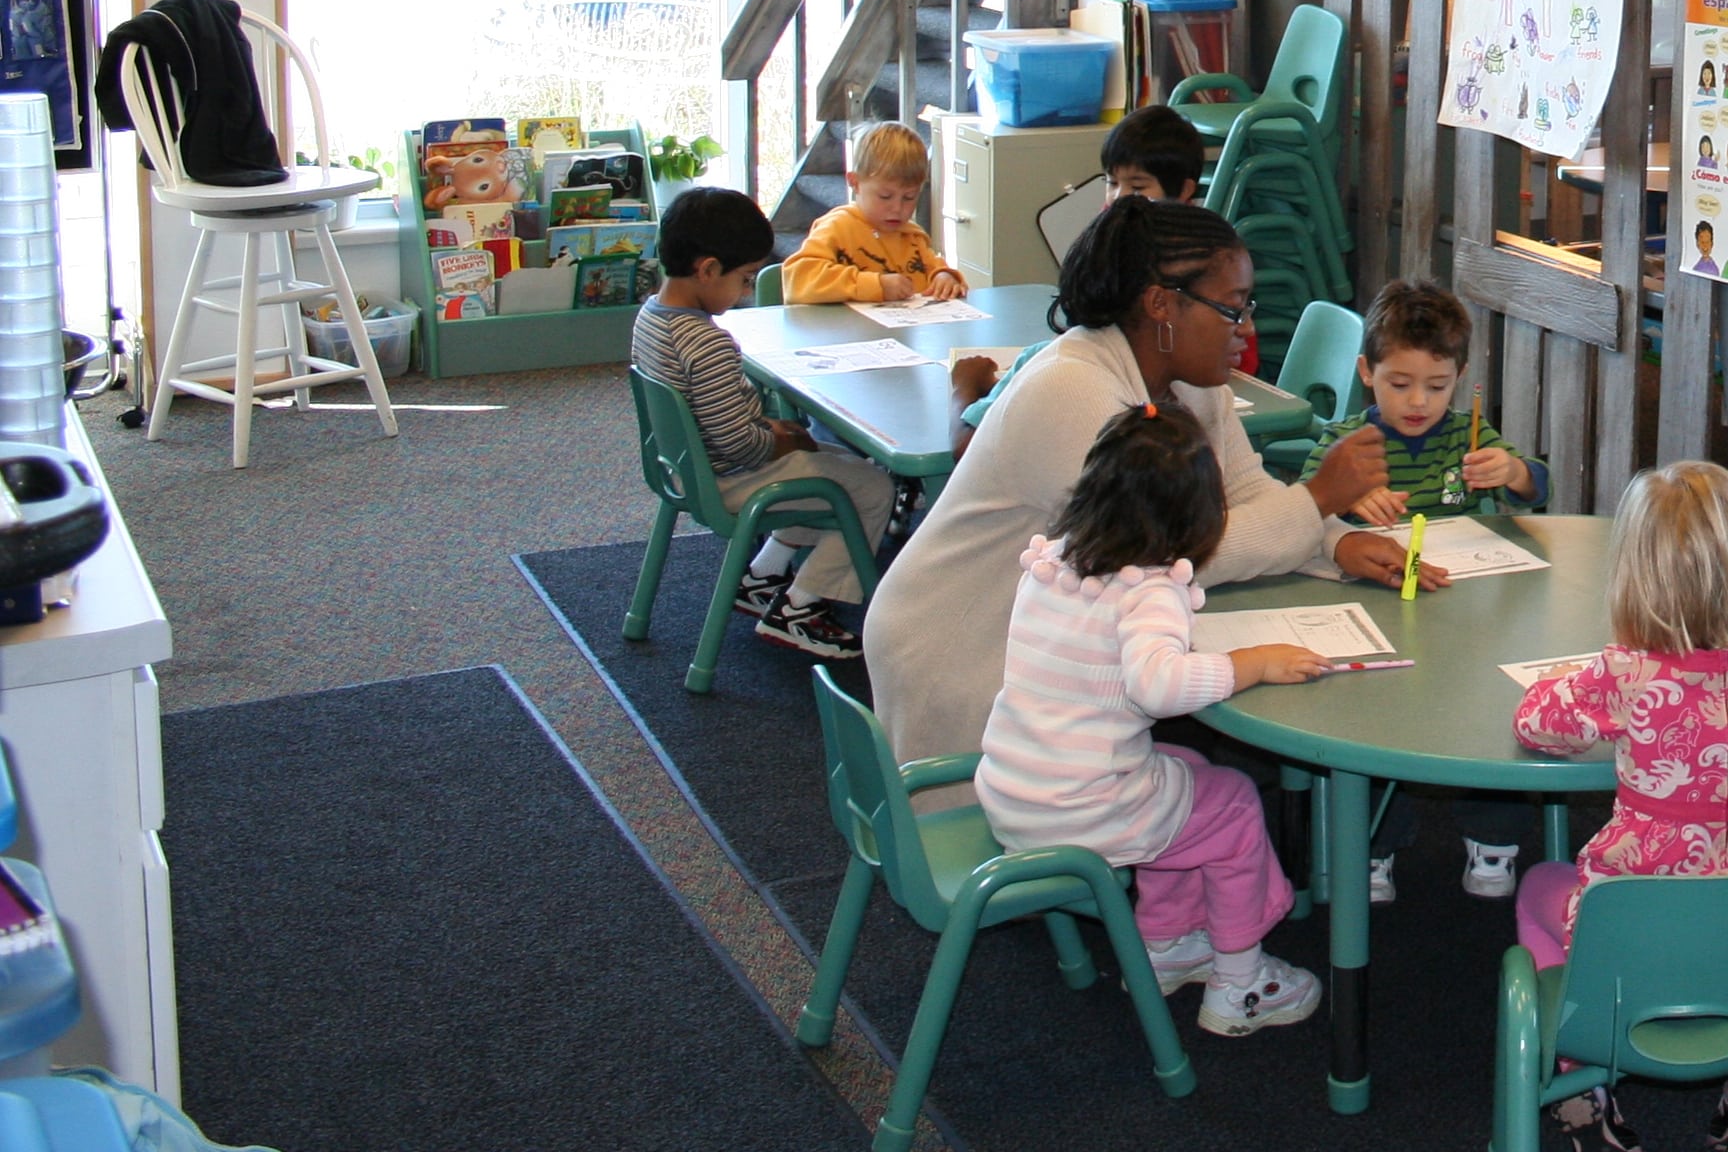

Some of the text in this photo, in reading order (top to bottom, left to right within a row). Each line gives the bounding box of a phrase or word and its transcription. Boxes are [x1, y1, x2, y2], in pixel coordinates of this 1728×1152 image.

[1462, 41, 1485, 67] frog
[1577, 47, 1603, 61] friends
[443, 260, 487, 274] MONKEYS
